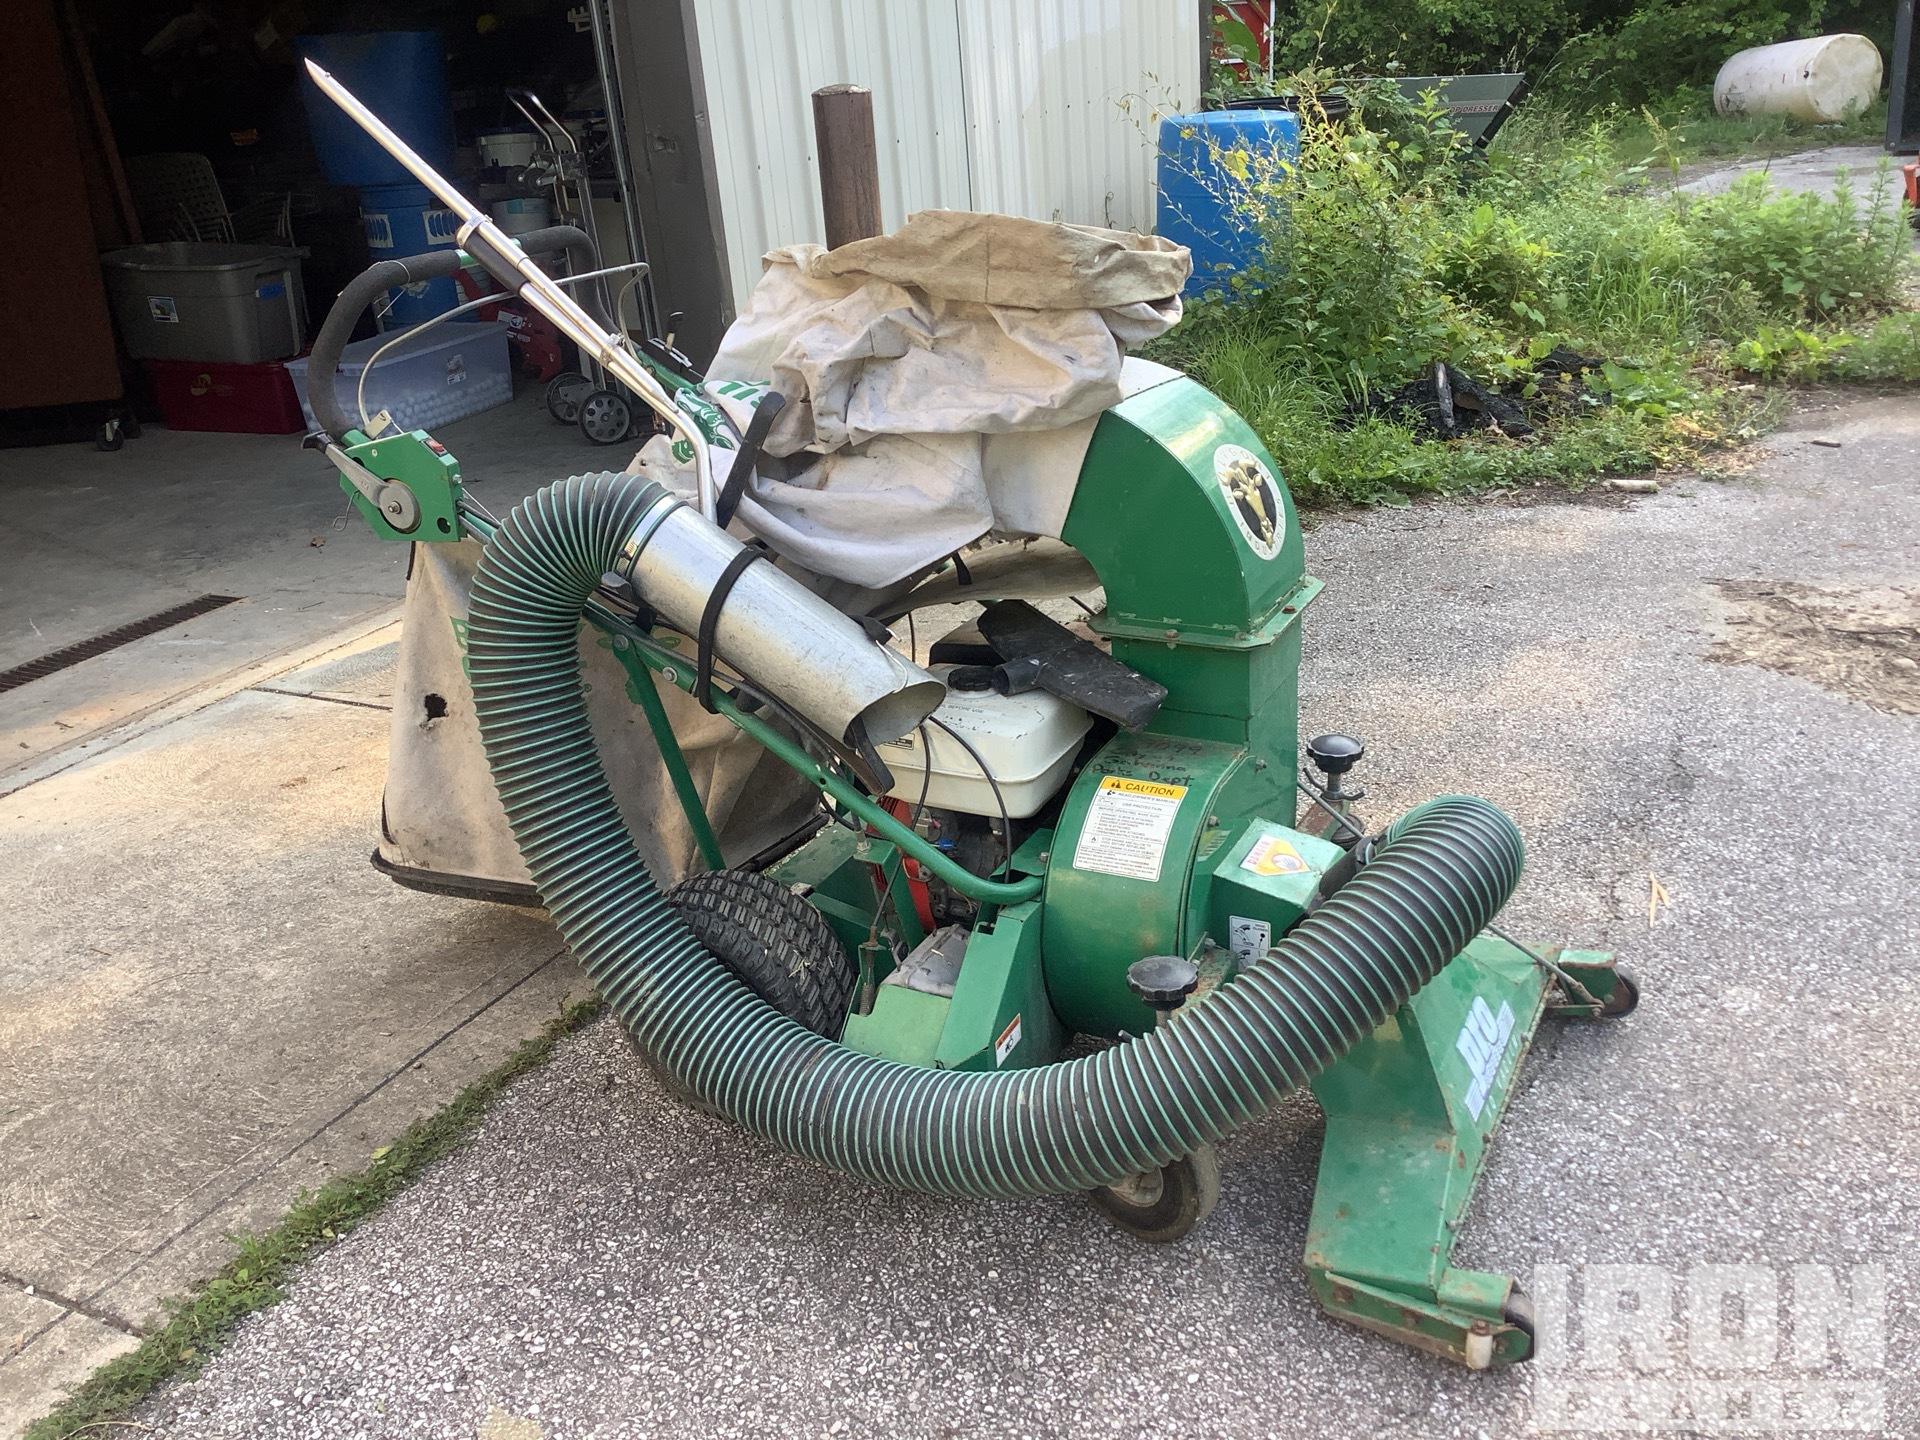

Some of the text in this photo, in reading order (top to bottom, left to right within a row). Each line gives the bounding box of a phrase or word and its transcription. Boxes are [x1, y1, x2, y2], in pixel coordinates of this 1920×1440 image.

[1462, 105, 1499, 113] DRESSER
[1092, 763, 1133, 777] Parks
[1125, 782, 1176, 797] CAUTION
[1247, 842, 1269, 865] DANGER
